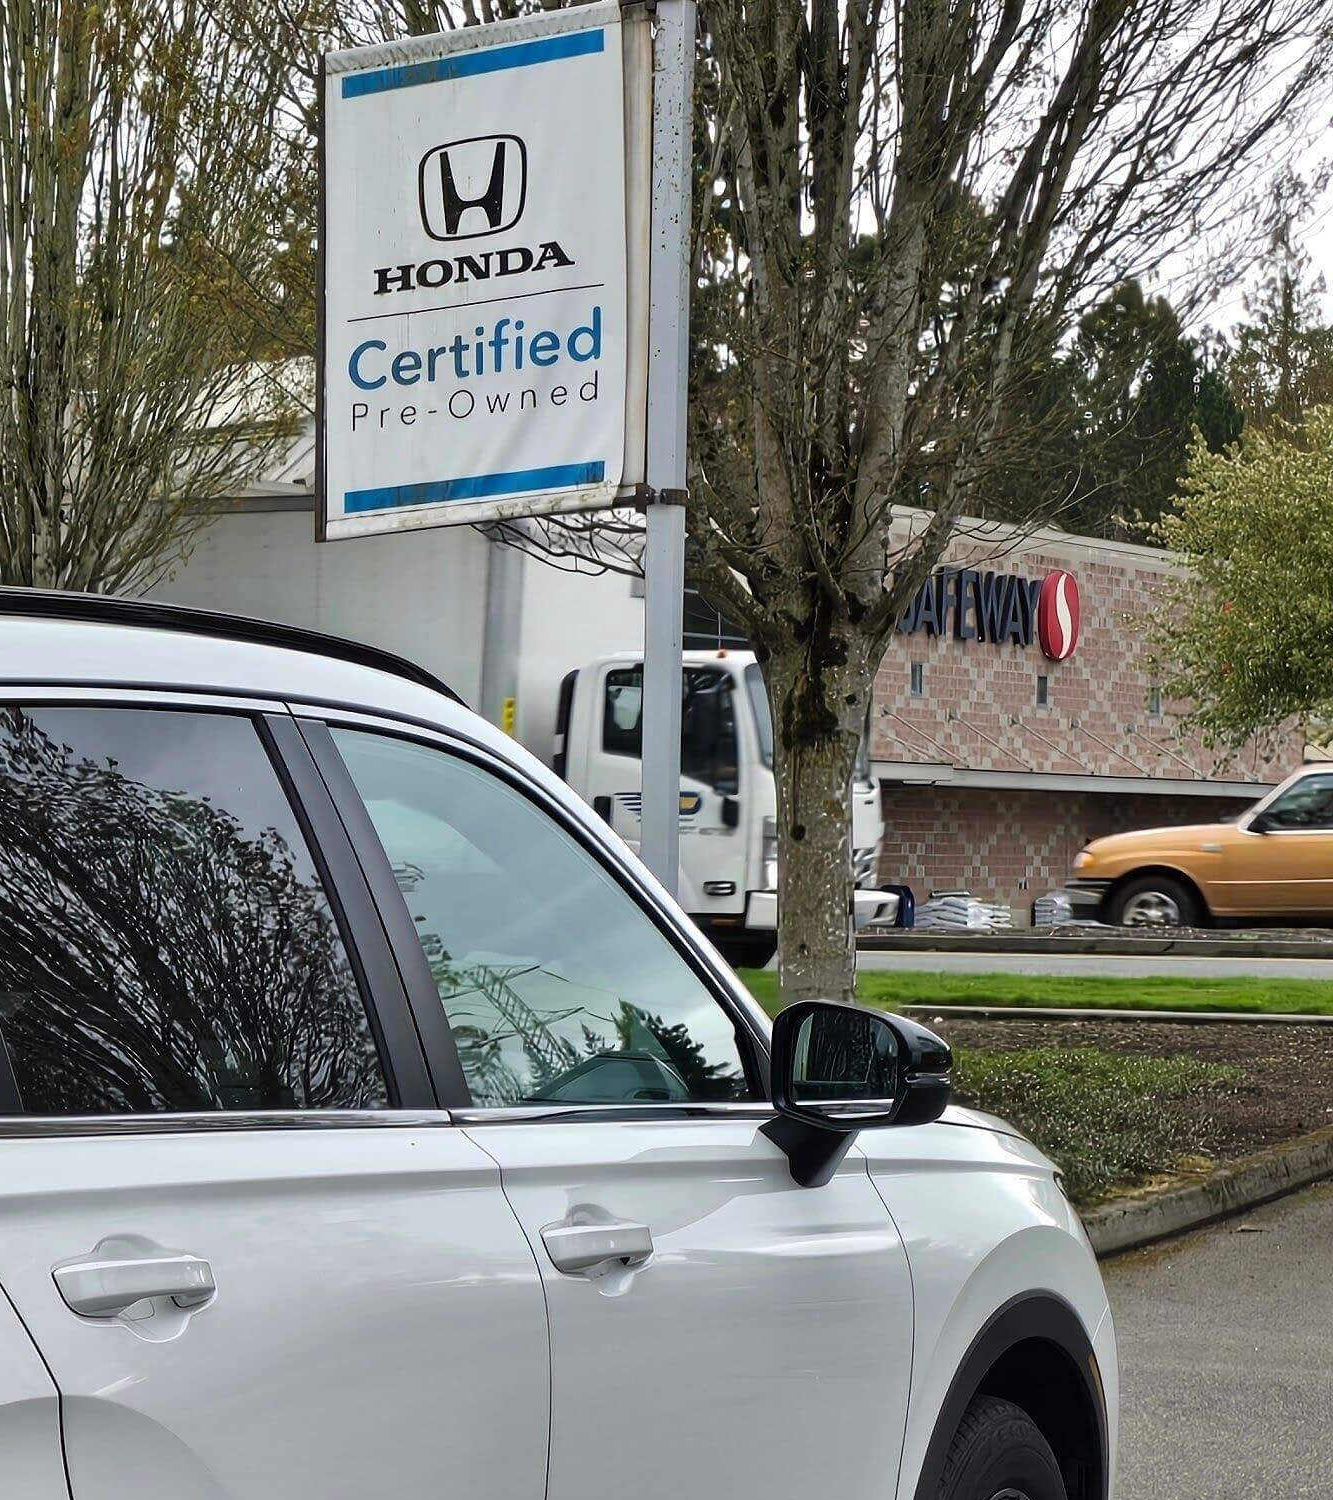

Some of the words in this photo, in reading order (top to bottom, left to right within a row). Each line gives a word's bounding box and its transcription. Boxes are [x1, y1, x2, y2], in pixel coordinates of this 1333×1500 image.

[373, 241, 575, 295] HONDA
[347, 306, 602, 391] Certified
[352, 371, 599, 432] Pre-Owned
